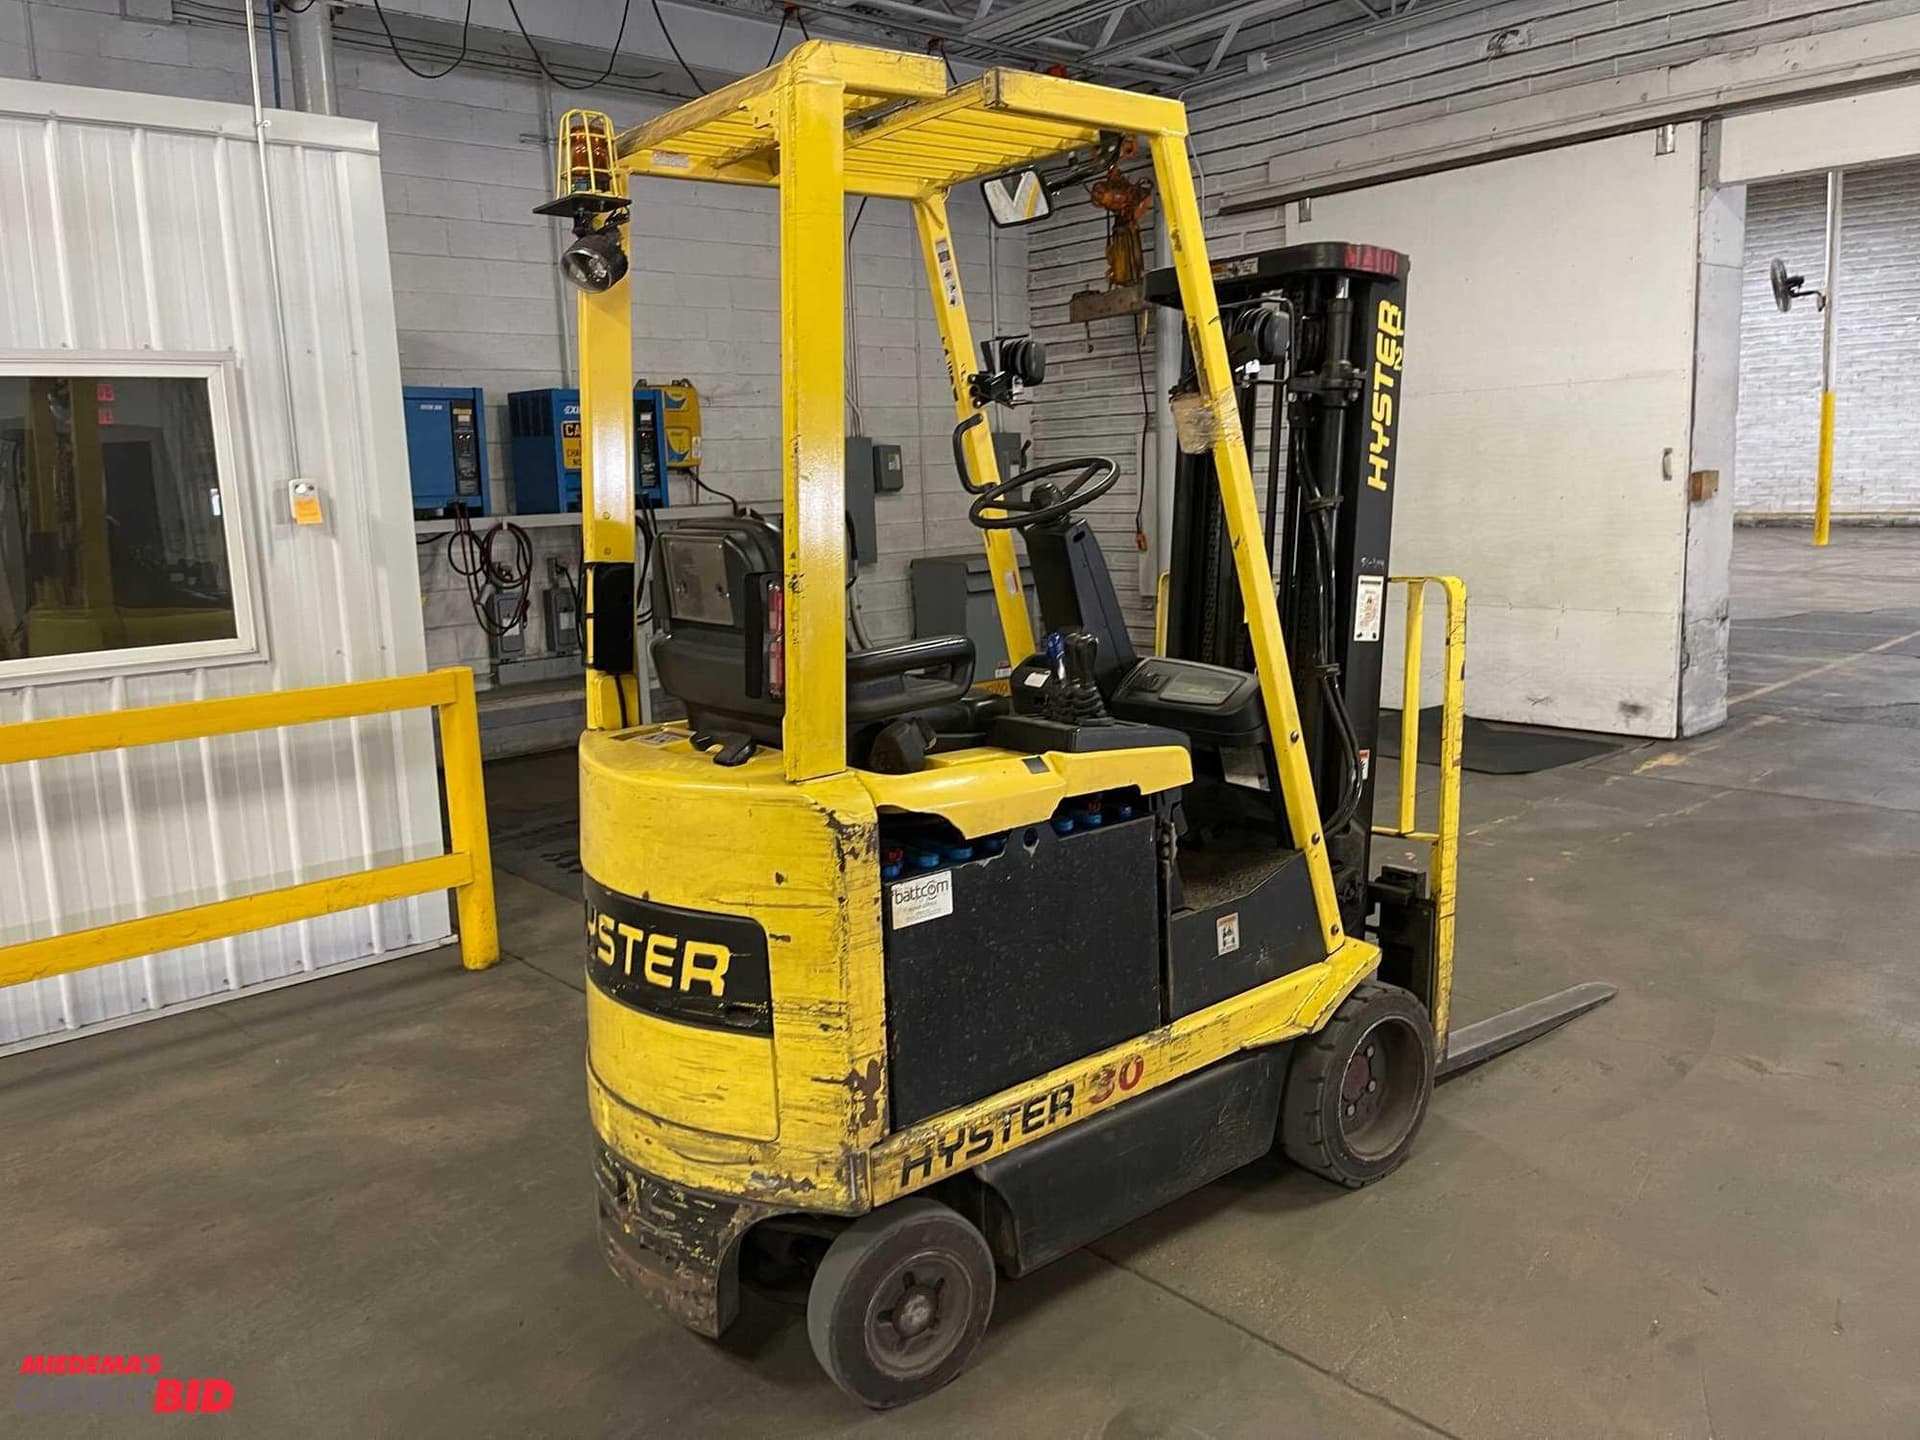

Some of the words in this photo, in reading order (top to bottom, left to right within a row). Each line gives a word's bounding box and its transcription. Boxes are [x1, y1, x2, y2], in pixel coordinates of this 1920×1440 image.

[1367, 299, 1400, 492] HYSTER
[587, 905, 731, 997] YSTER
[900, 1083, 1075, 1187] HYSTER
